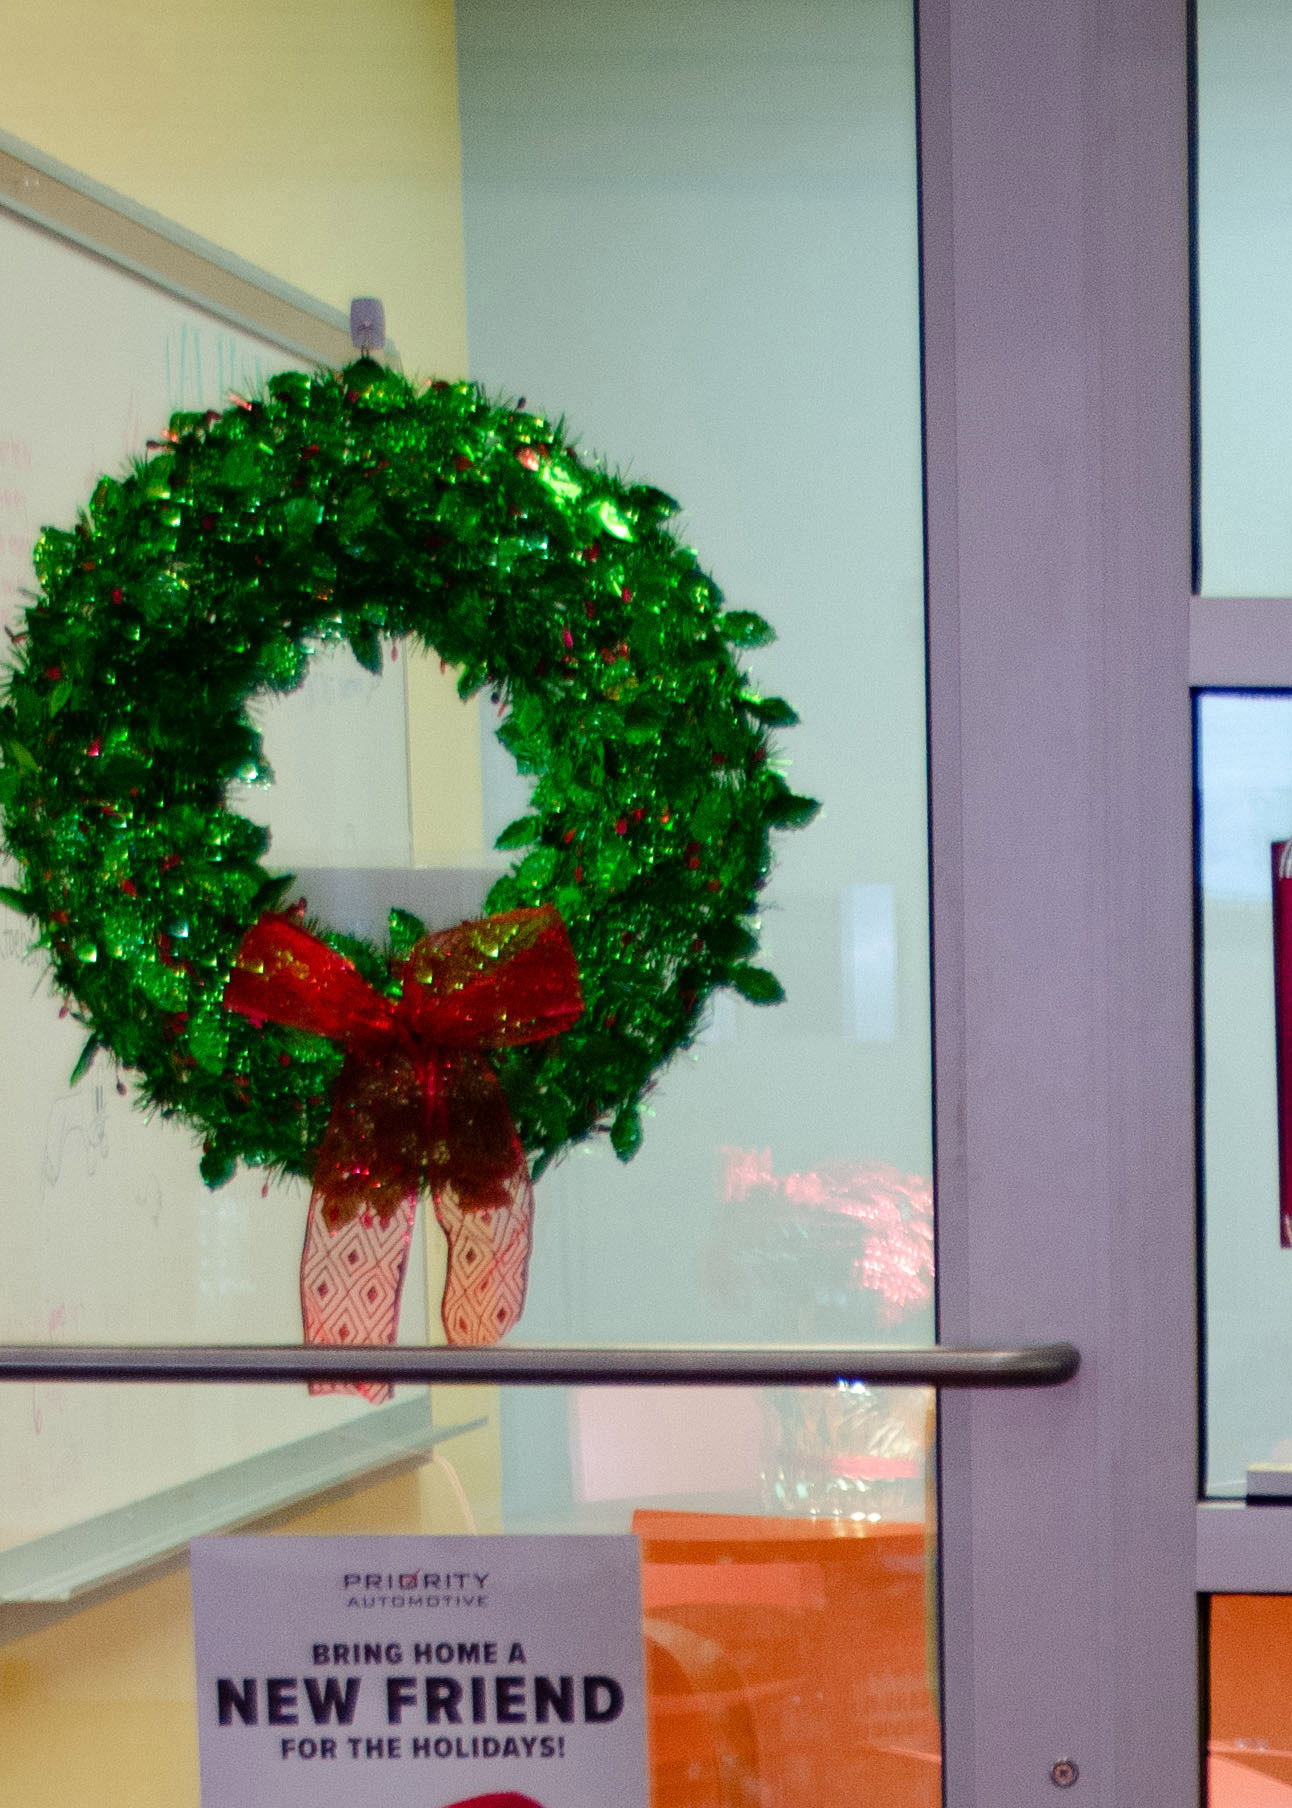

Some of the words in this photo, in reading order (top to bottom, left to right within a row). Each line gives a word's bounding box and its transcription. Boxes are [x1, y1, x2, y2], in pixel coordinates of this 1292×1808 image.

[343, 1570, 490, 1590] PRIORITY
[346, 1594, 489, 1609] AUTOMOTIVE
[312, 1642, 402, 1665] BRING
[413, 1641, 498, 1665] HOME
[508, 1641, 527, 1664] A
[216, 1677, 362, 1727] NEW
[386, 1675, 625, 1725] FRIEND
[281, 1738, 337, 1760] FOR
[348, 1737, 401, 1759] THE
[412, 1736, 566, 1758] HOLIDAYS!
